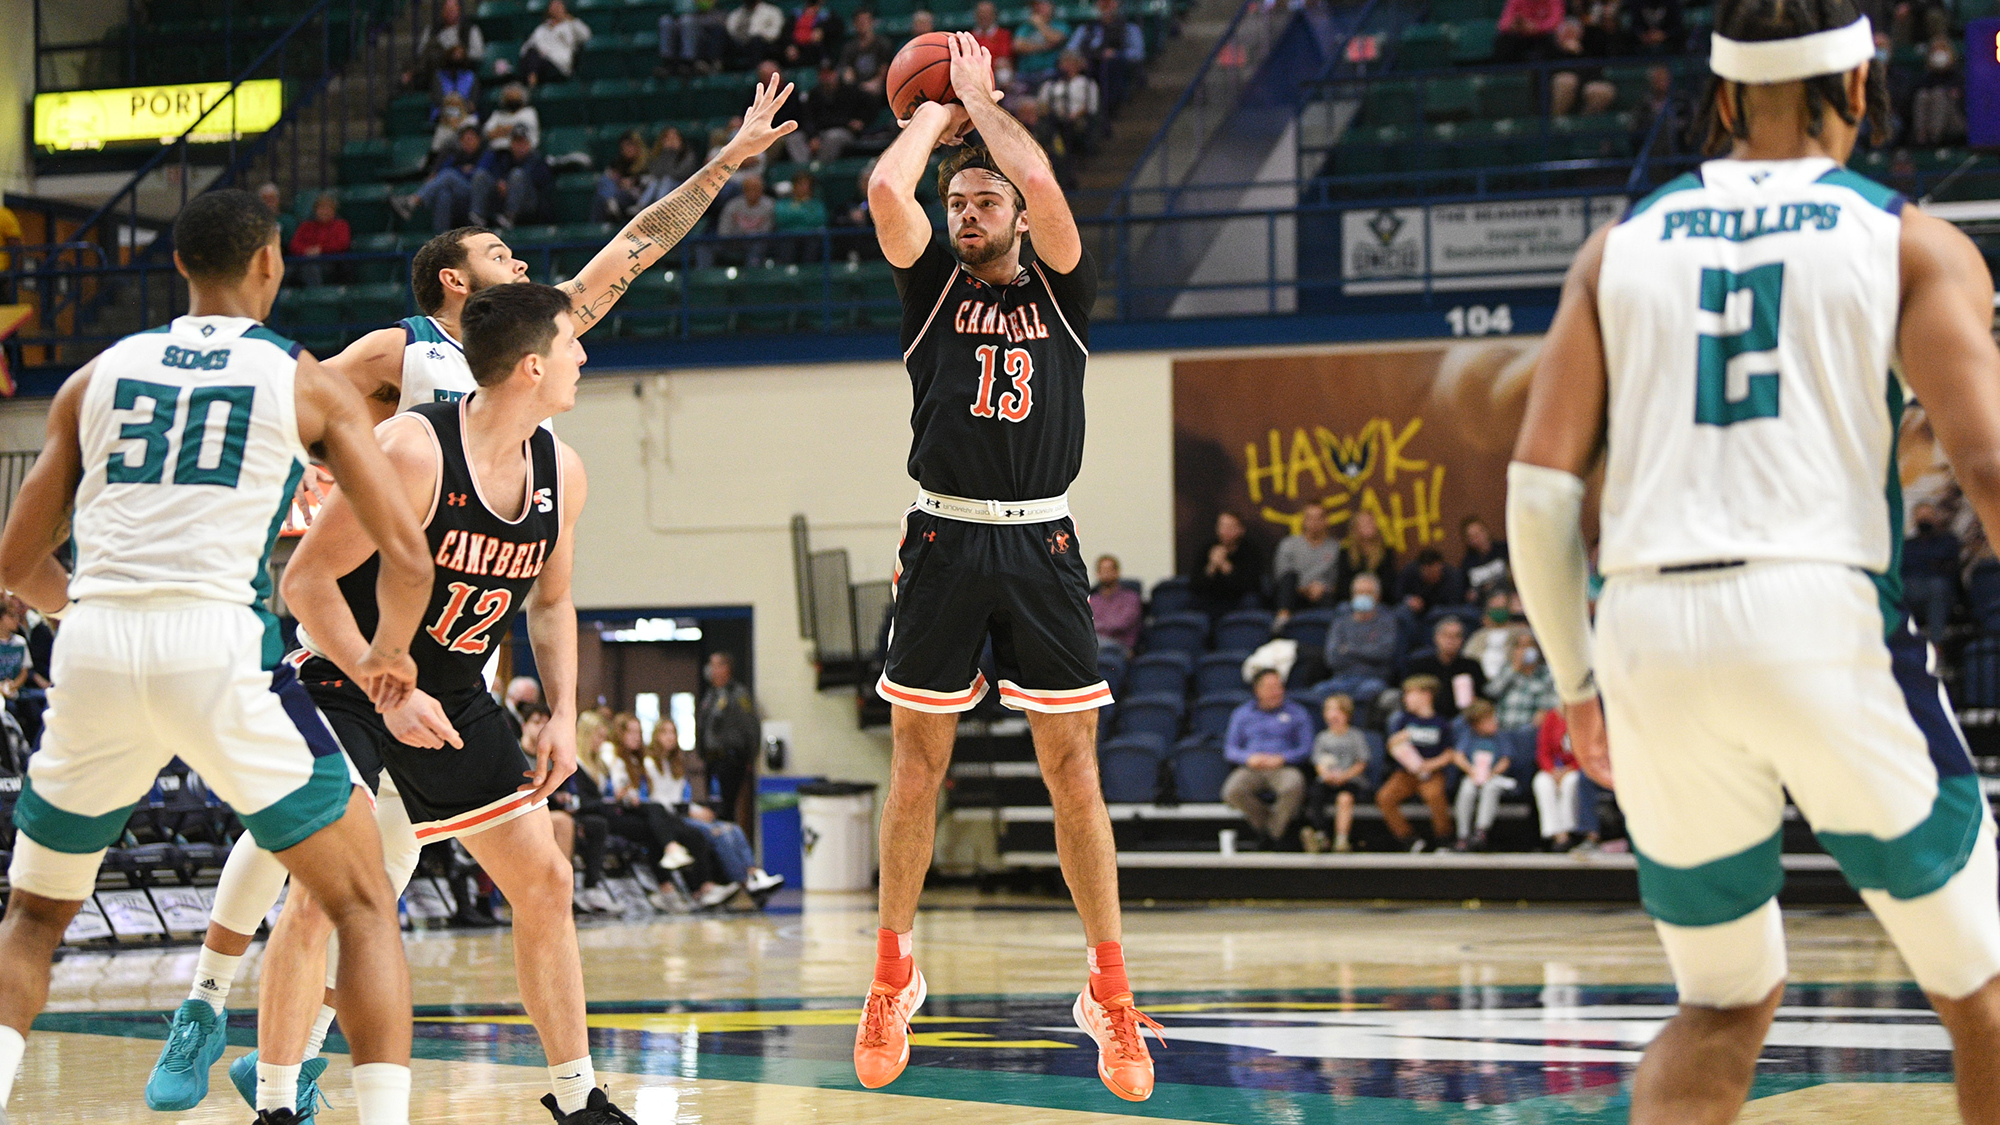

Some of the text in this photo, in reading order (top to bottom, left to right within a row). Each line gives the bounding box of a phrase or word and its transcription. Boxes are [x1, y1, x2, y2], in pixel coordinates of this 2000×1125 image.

[131, 90, 208, 116] PORT
[1660, 202, 1842, 243] PHILLIPS
[954, 299, 1050, 343] CAMELL
[1446, 304, 1514, 336] 104
[1694, 261, 1785, 427] 2
[161, 345, 231, 371] SIMS
[970, 344, 1035, 423] 13
[106, 378, 256, 489] 30
[1244, 416, 1429, 503] HAWK
[435, 529, 548, 579] CAMPBELL
[425, 581, 513, 655] 12
